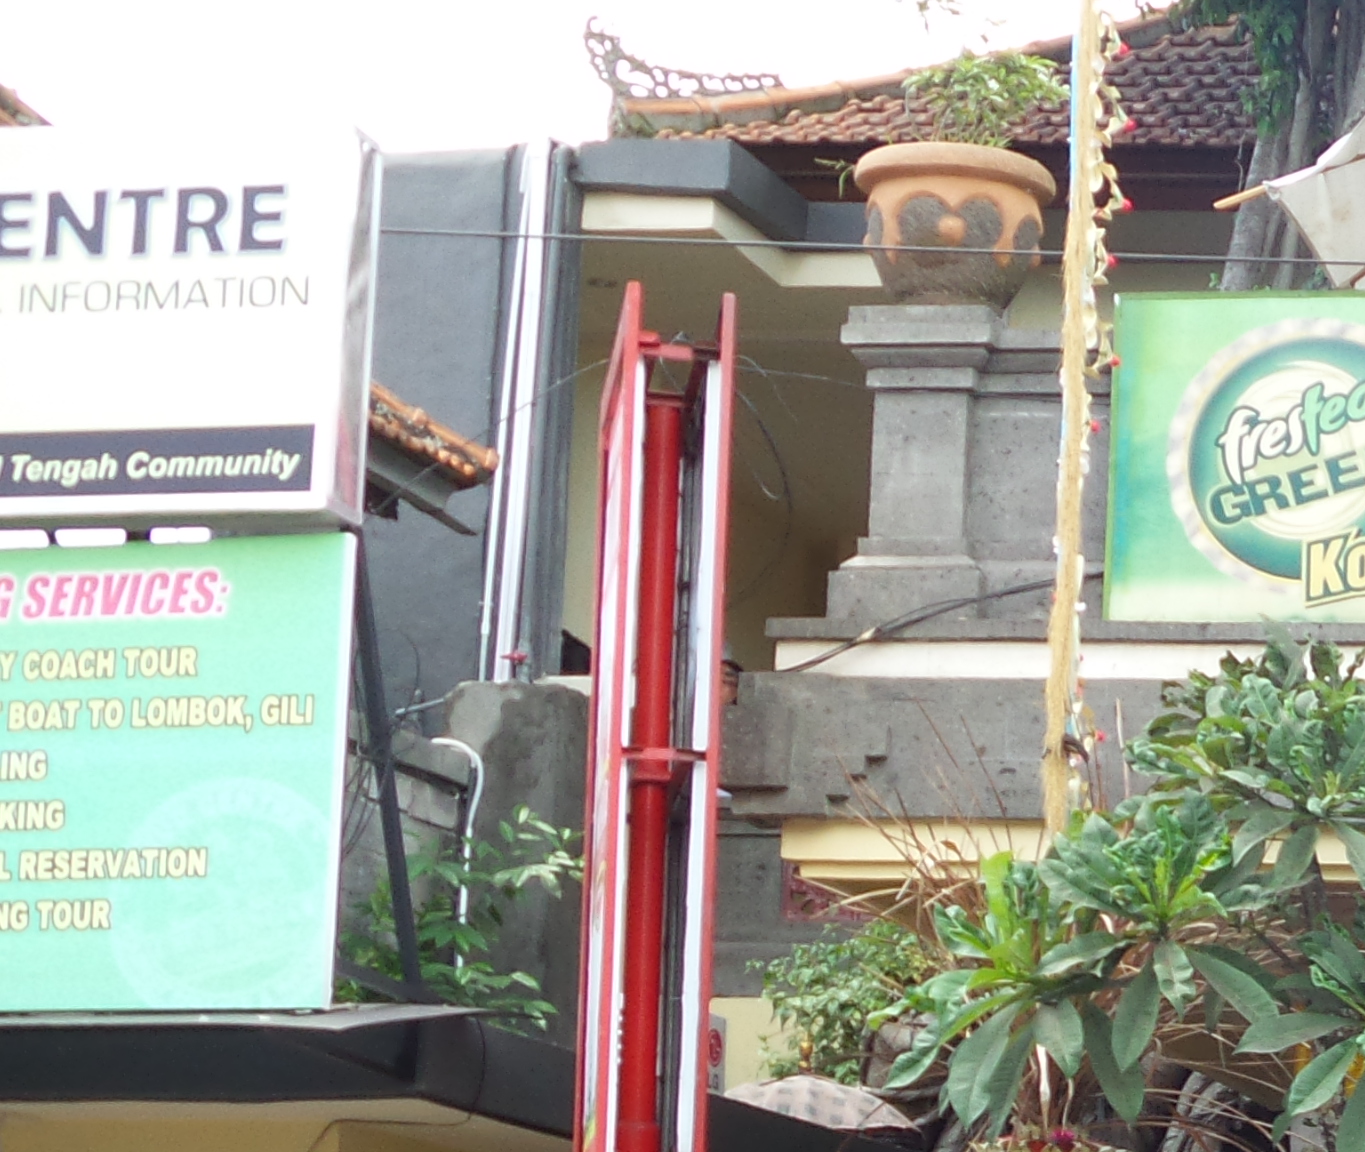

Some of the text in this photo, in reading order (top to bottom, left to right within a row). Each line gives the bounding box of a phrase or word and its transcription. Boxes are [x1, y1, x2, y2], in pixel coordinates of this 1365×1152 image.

[19, 275, 309, 313] INFORMATION
[11, 448, 301, 488] Tengah Community
[20, 570, 230, 619] SERVICES:
[22, 649, 115, 681] COACH
[124, 646, 198, 678] TOUR
[7, 693, 315, 733] BOAT TO LOMBOK, GILI
[18, 847, 208, 882] RESERVATION
[36, 899, 111, 931] TOUR
